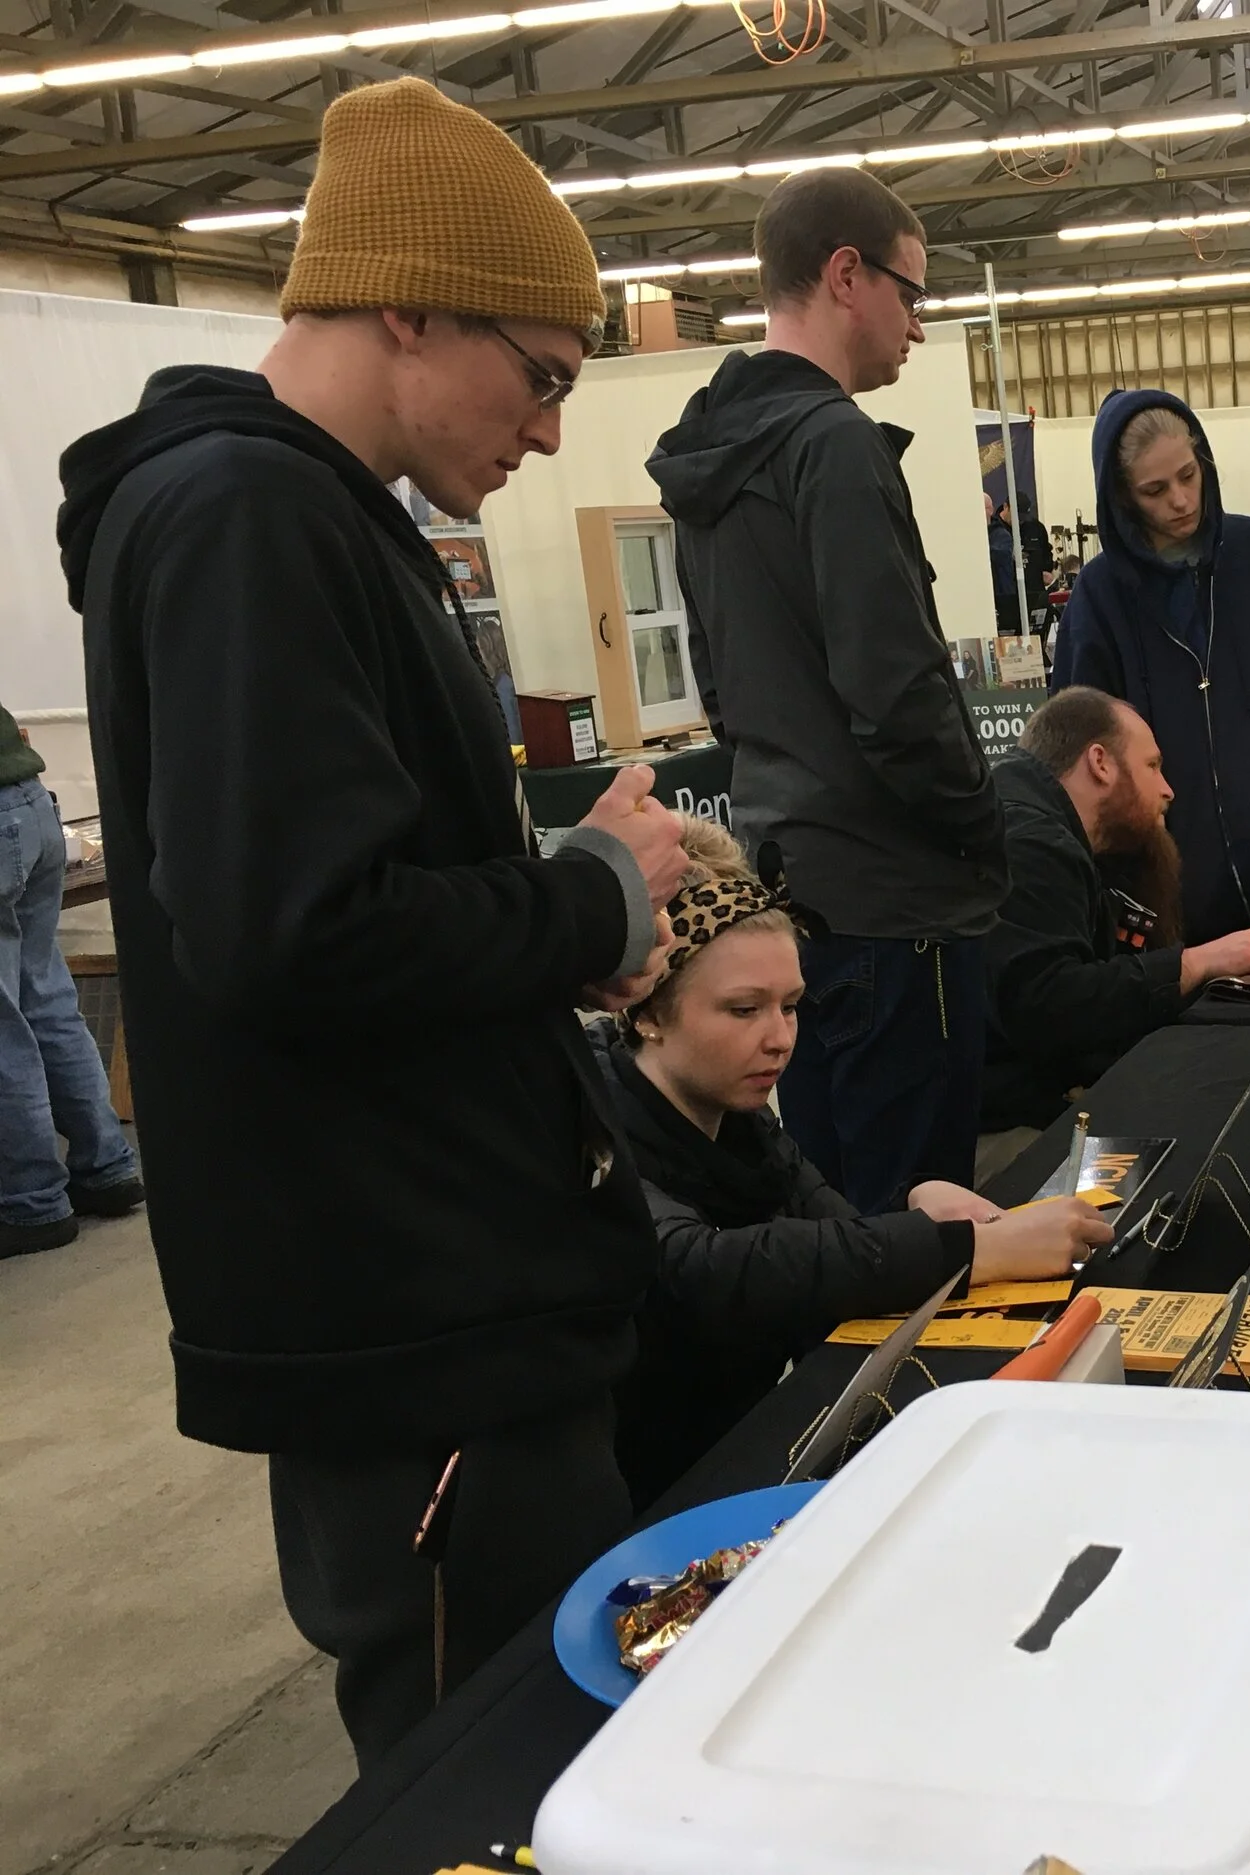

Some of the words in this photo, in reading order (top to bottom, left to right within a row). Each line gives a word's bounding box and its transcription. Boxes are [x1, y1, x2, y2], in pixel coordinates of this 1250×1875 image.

[973, 705, 990, 716] TO
[993, 703, 1021, 715] WIN
[1025, 703, 1035, 713] A
[1125, 1296, 1155, 1317] APRIL
